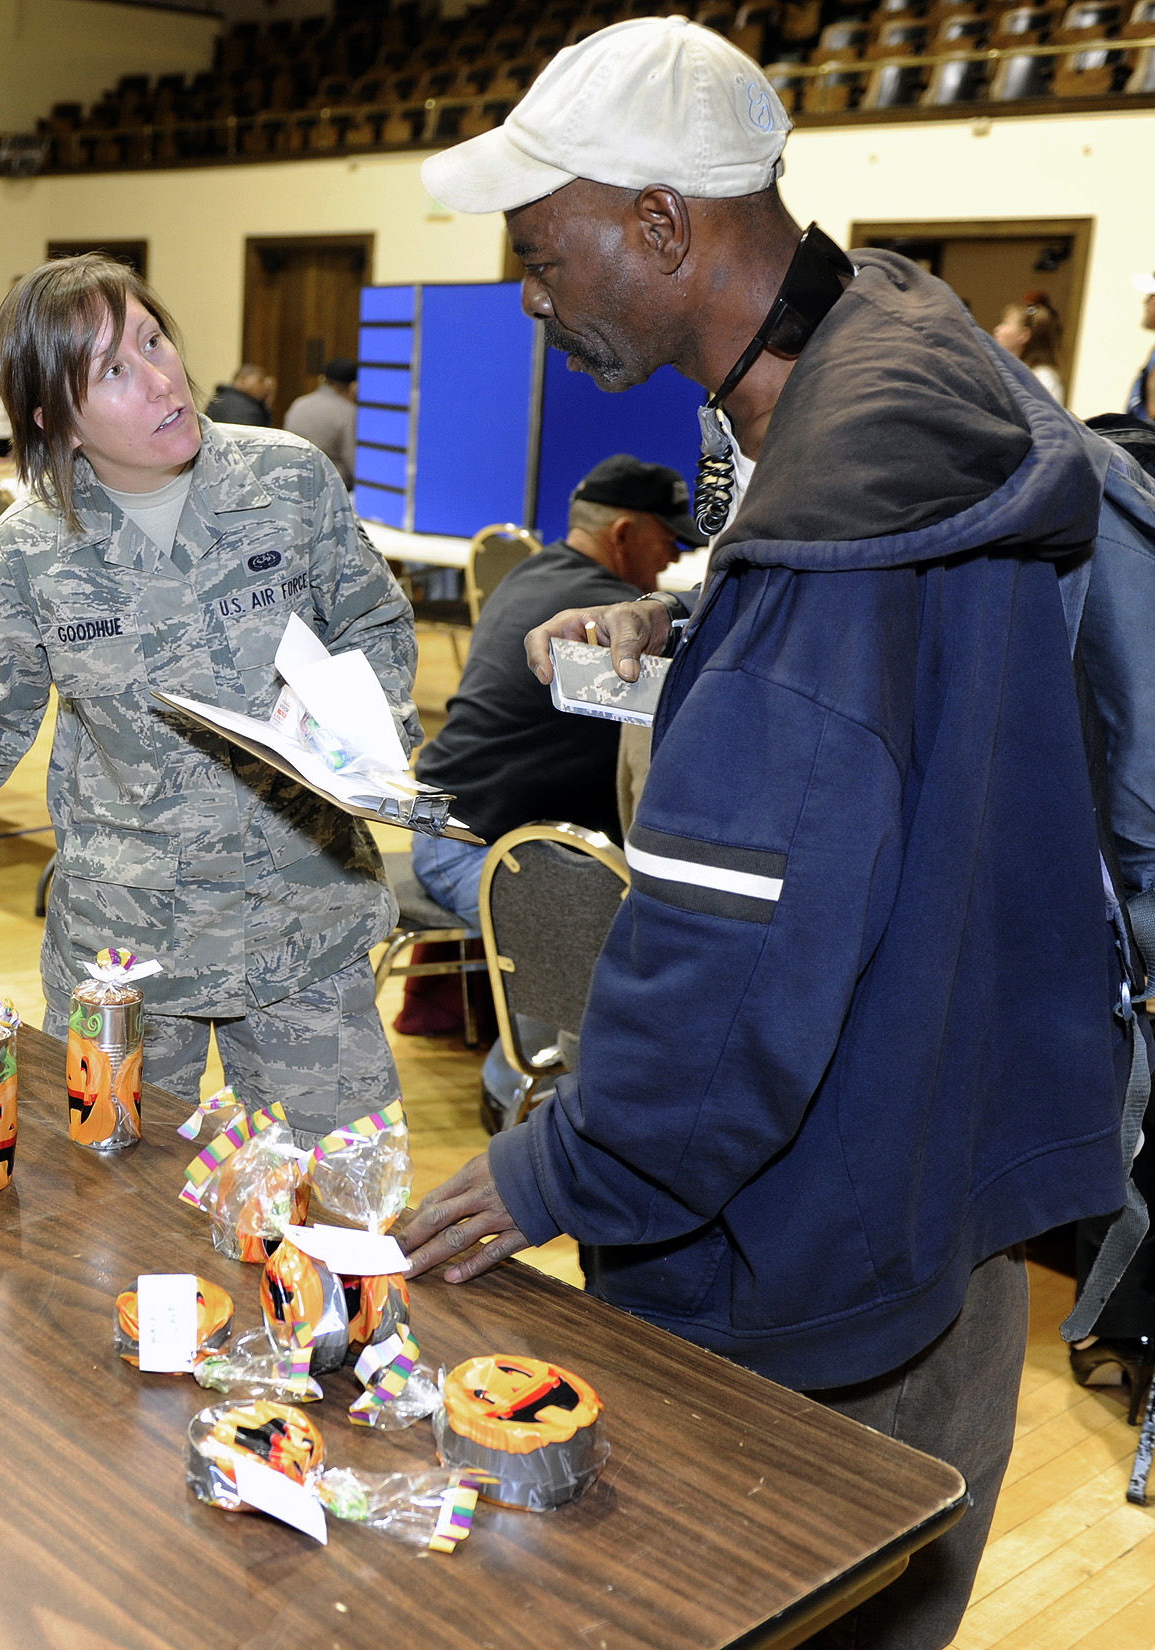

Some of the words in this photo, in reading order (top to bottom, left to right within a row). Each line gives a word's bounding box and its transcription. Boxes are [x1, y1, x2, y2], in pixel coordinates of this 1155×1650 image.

[219, 598, 246, 617] U.S.
[251, 587, 276, 609] AIR
[281, 572, 308, 599] FORCE
[57, 616, 124, 644] GOODHUE
